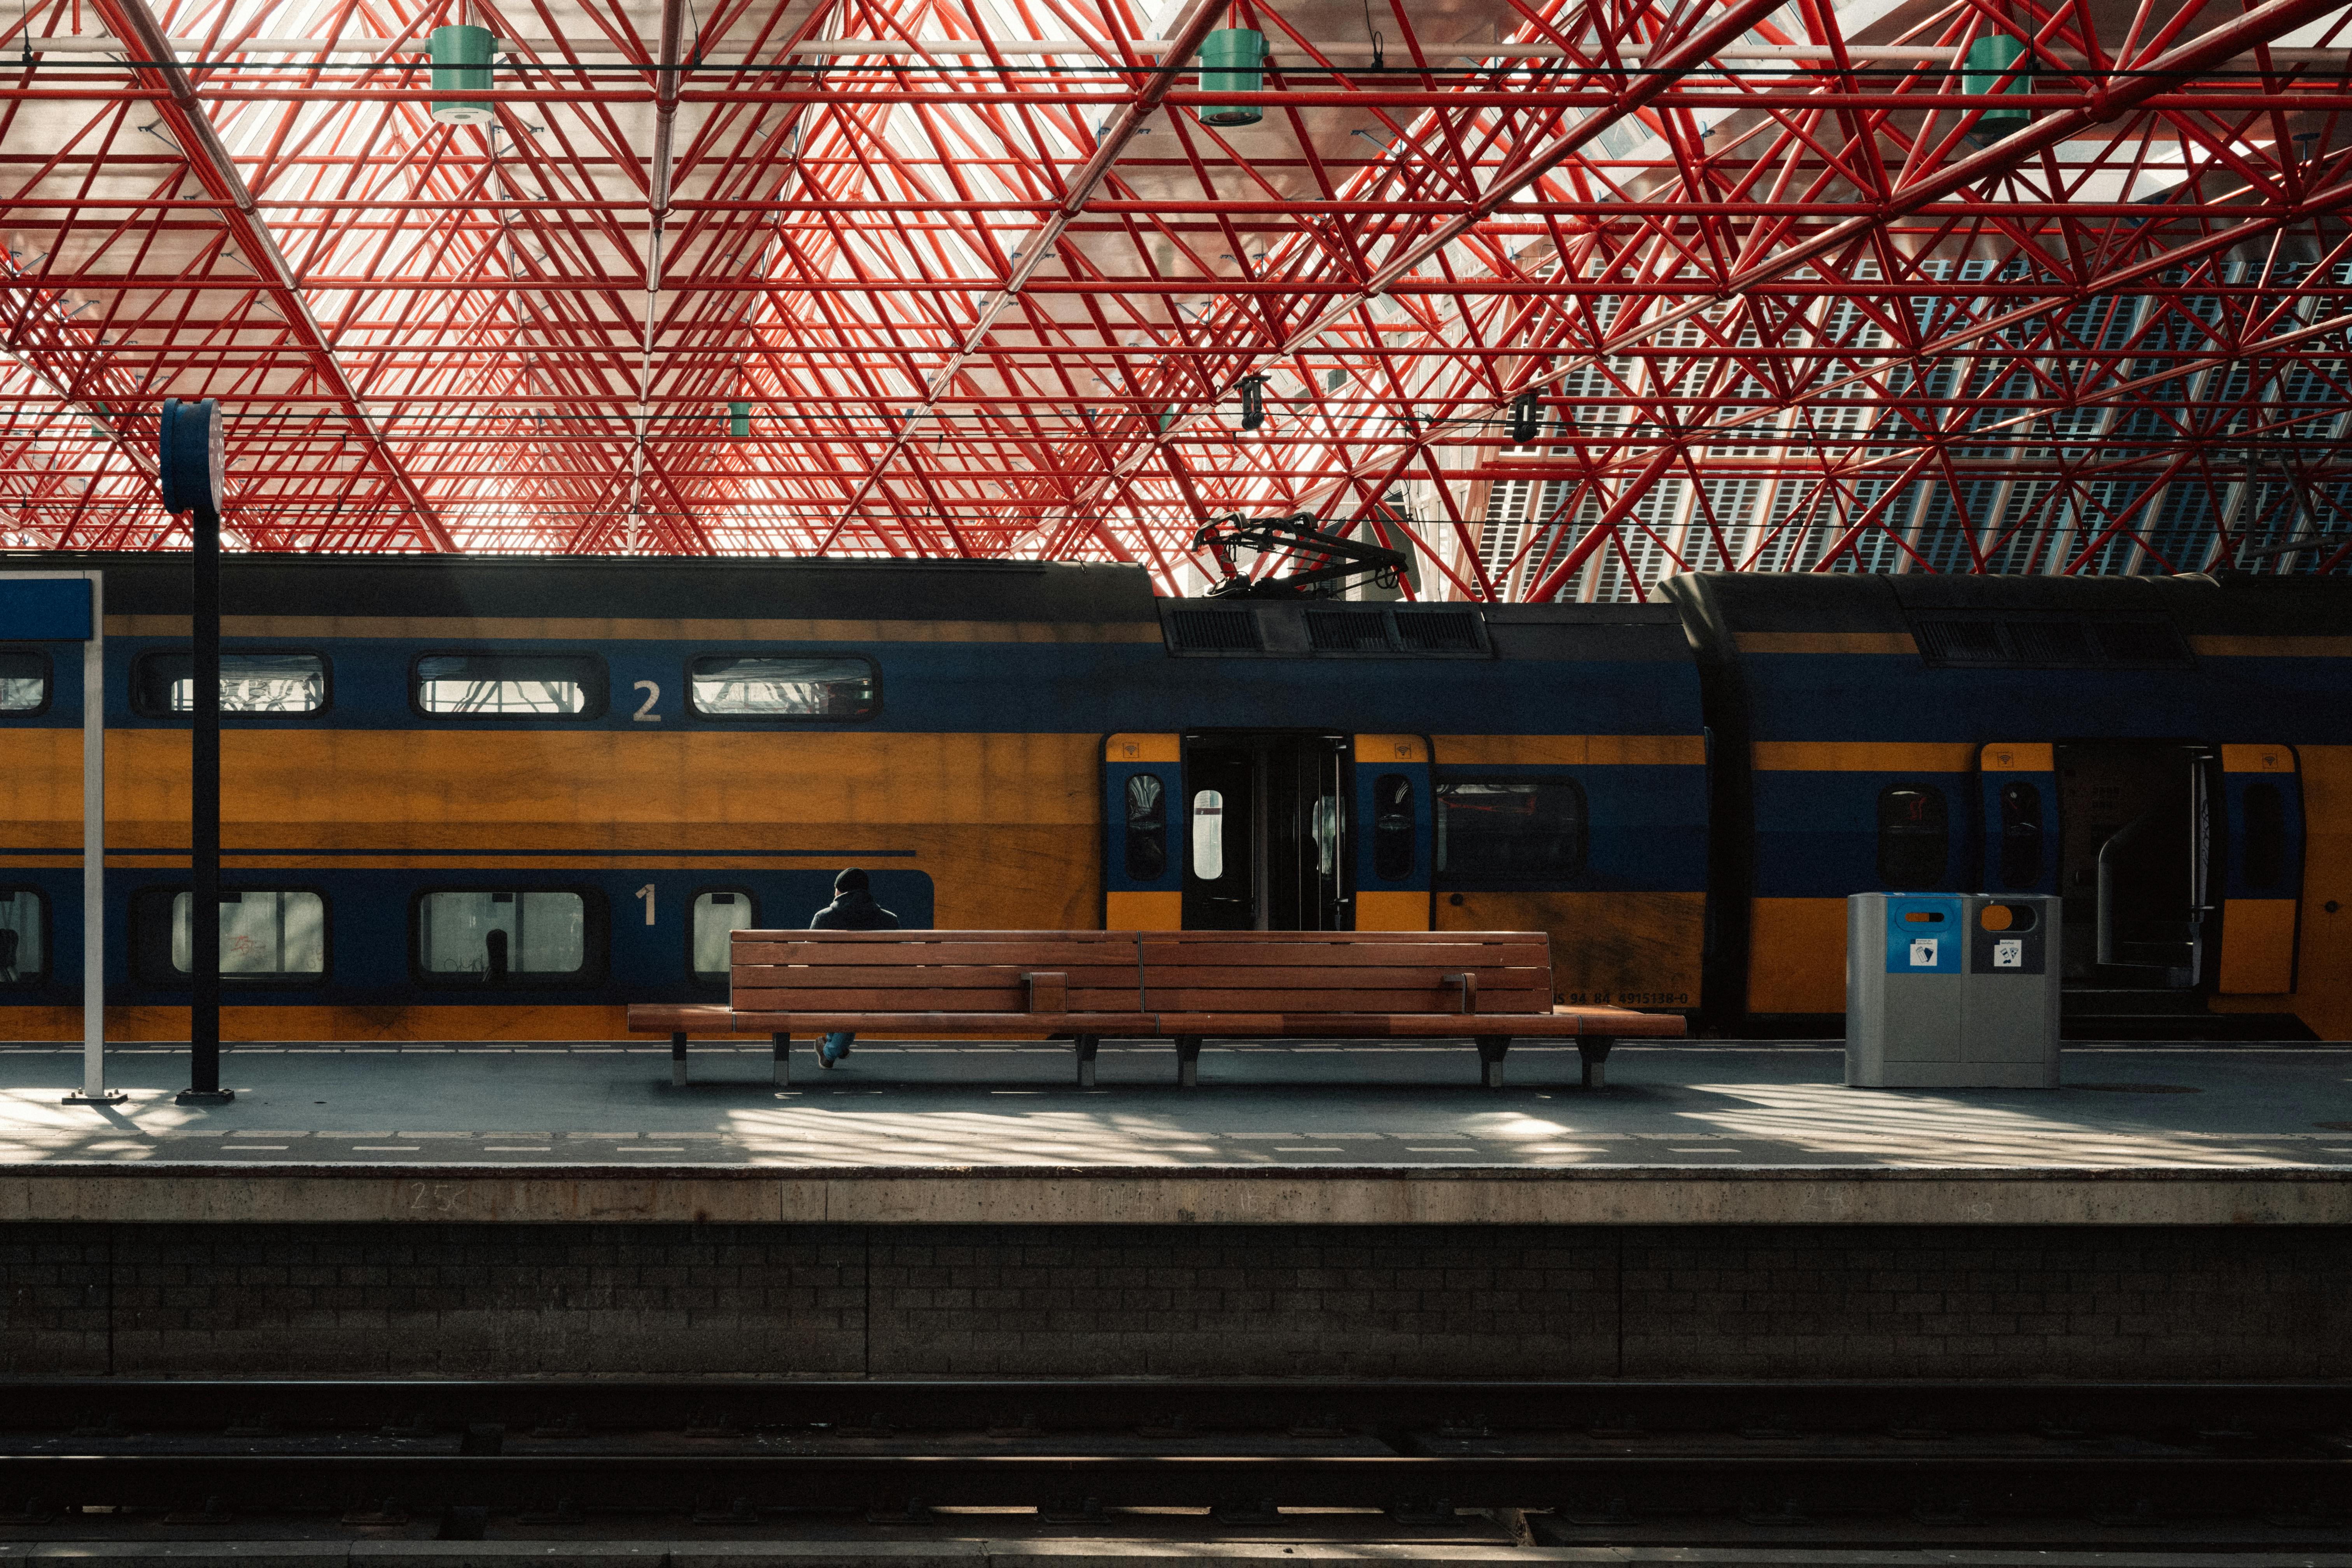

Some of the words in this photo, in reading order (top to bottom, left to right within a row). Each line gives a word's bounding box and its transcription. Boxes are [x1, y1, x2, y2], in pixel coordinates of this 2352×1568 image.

[633, 680, 661, 722] 2
[635, 884, 655, 926] 1
[1570, 993, 1586, 1004] 94
[1595, 993, 1610, 1004] 84
[1618, 993, 1688, 1004] 4915138-0
